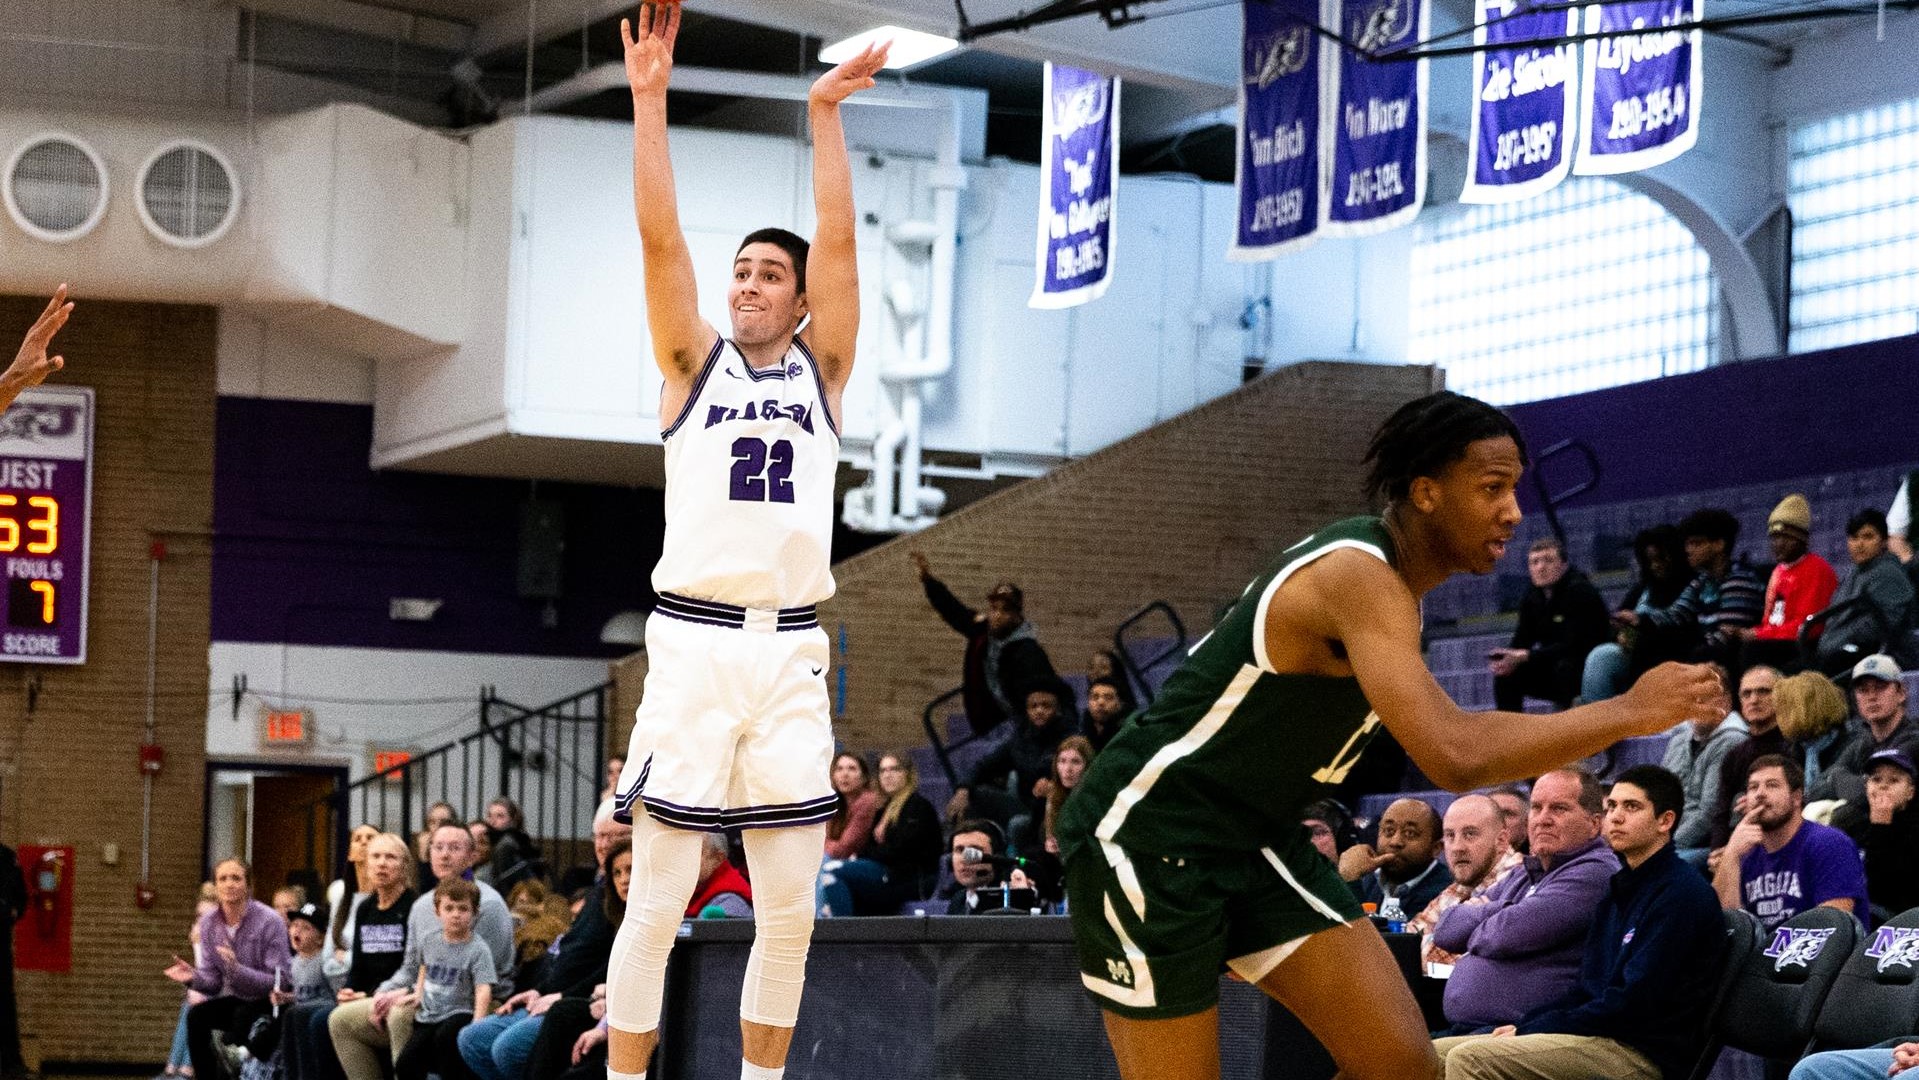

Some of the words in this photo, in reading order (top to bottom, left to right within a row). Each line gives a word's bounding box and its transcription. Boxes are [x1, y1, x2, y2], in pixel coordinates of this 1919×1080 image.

[729, 436, 796, 504] 22
[6, 557, 64, 580] FOULS
[30, 580, 55, 624] 7
[3, 632, 60, 655] SCORE
